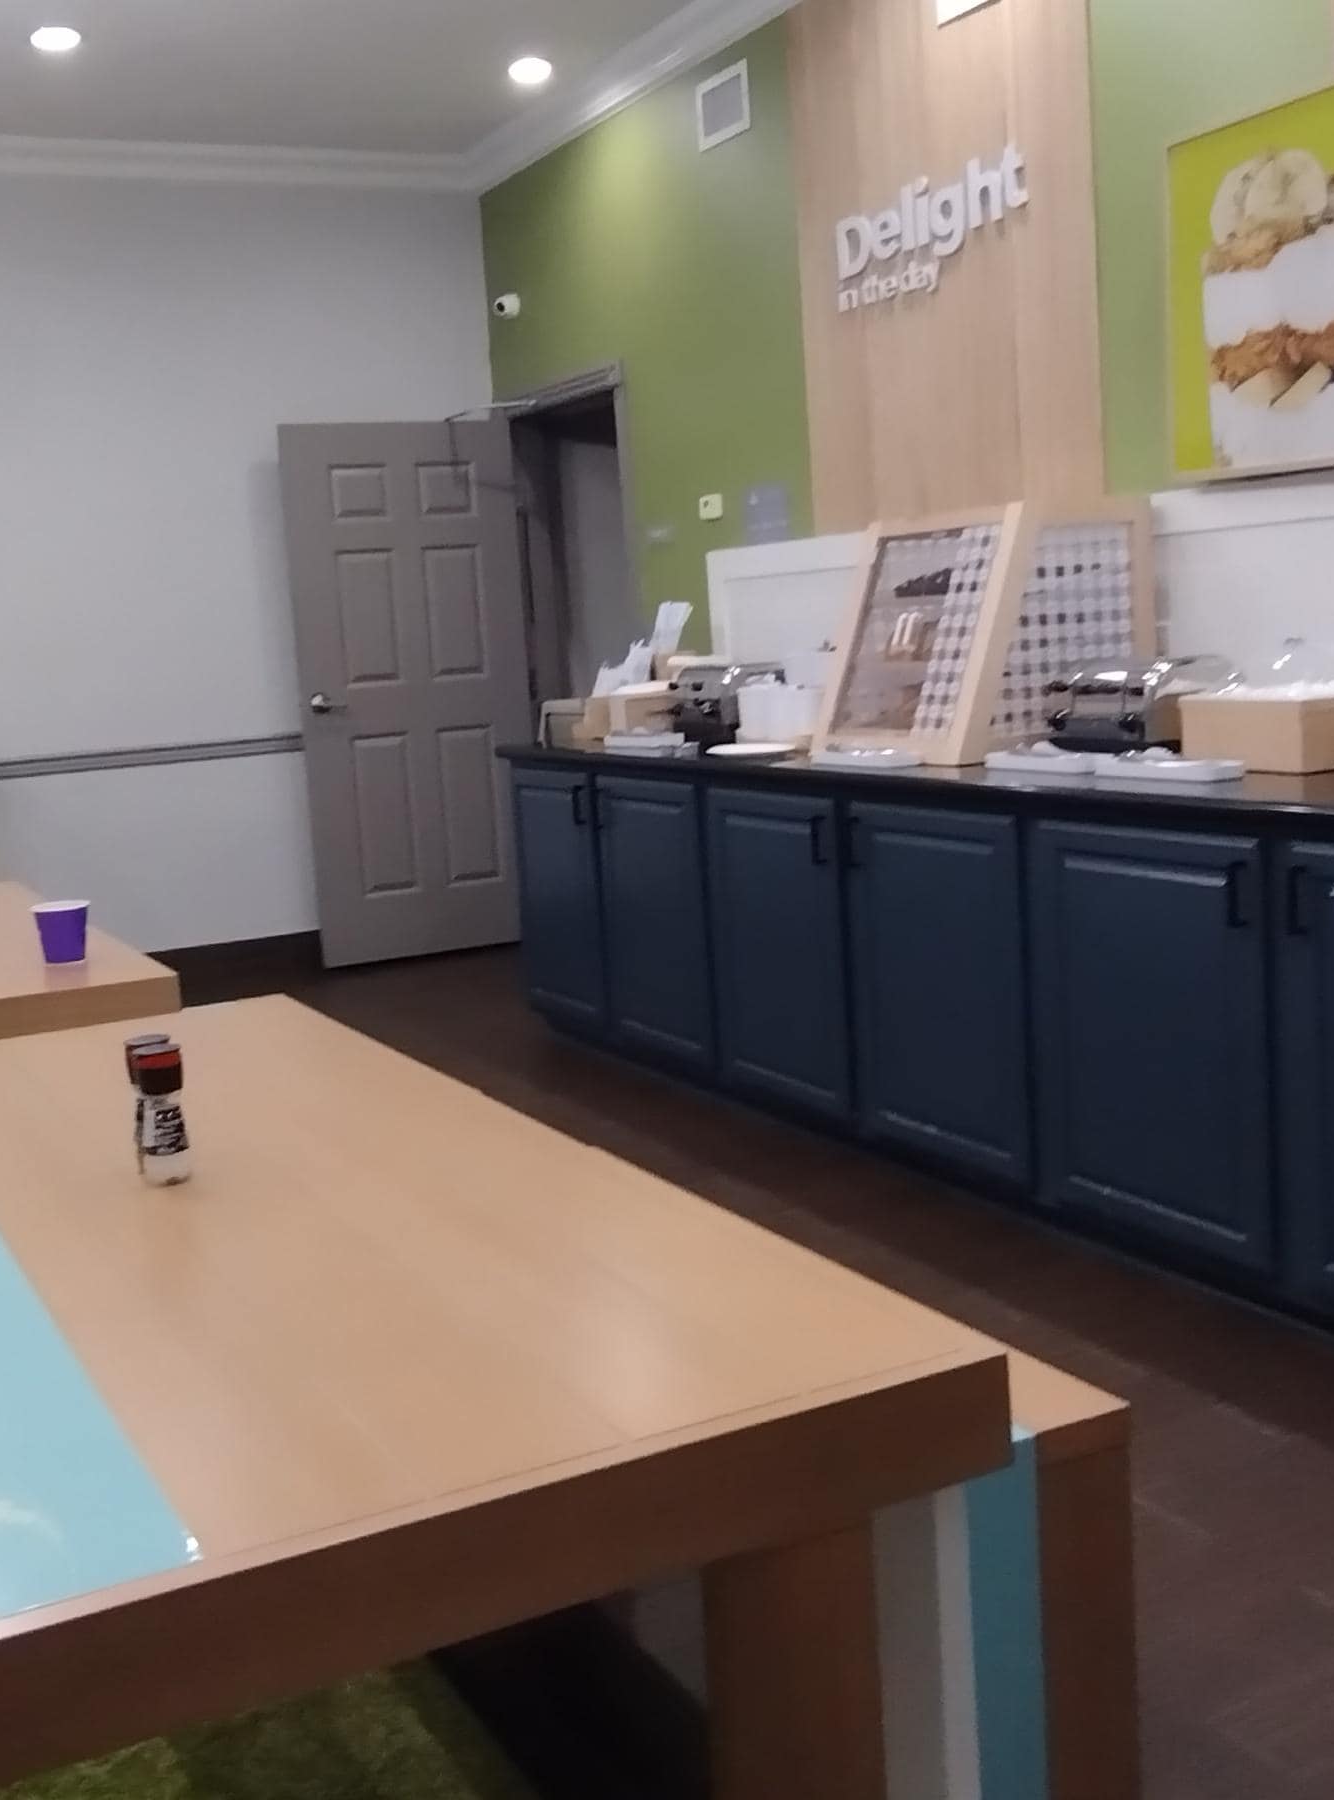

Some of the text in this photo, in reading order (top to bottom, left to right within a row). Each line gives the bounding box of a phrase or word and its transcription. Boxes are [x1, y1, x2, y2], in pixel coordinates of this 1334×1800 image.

[835, 141, 1029, 281] Delight
[836, 259, 940, 313] in the day
